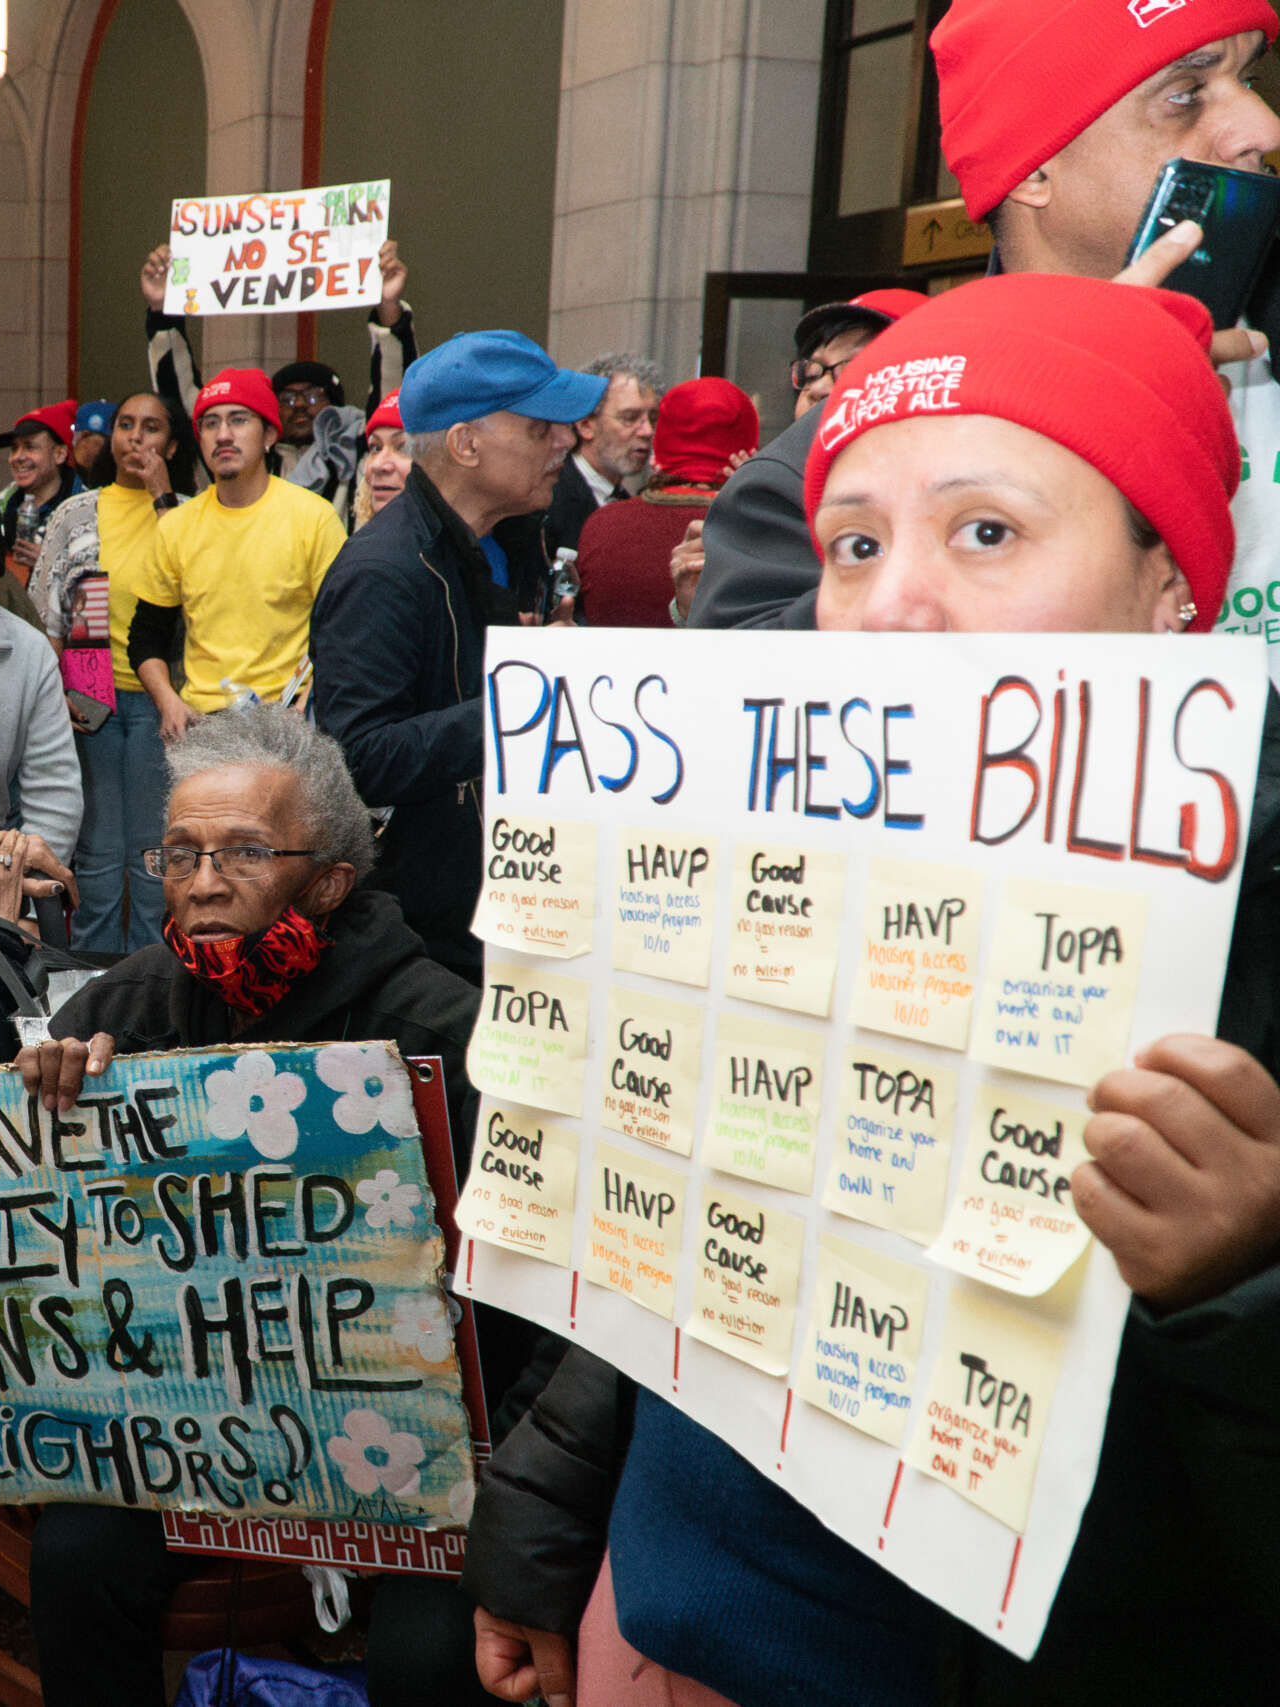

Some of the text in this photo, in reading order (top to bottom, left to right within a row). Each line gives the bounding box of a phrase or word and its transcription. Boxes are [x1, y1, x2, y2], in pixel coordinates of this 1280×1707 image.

[319, 183, 386, 227] PARK
[223, 230, 330, 272] NO SE
[210, 257, 373, 309] VENDE!
[860, 373, 963, 407] JUSTICE
[865, 355, 967, 389] HOUSING
[857, 390, 961, 427] FOR ALL
[487, 660, 684, 804] PASS
[743, 697, 924, 830] THESE
[492, 819, 555, 857] Good
[488, 855, 562, 884] Cause
[627, 844, 710, 888] HAVP
[751, 852, 806, 885] Good
[489, 890, 579, 912] no good reason
[746, 890, 814, 918] Cause
[883, 898, 966, 945] HAVP
[497, 922, 569, 940] no eviction
[1035, 912, 1124, 974] TOPA
[489, 984, 570, 1032] TOPA
[619, 1018, 672, 1061] Good
[611, 1058, 672, 1108] Cause
[730, 1056, 813, 1107] HAVP
[852, 1062, 934, 1118] TOPA
[76, 1082, 188, 1164] THE
[488, 1111, 543, 1161] Good
[990, 1107, 1063, 1159] Good
[480, 1150, 544, 1191] Cause
[981, 1150, 1071, 1205] Cause
[86, 1182, 144, 1246] TO
[155, 1167, 355, 1273] SHED
[472, 1187, 559, 1218] no good reason
[603, 1167, 675, 1229] HAVP
[476, 1217, 547, 1244] no eviction
[707, 1201, 765, 1245] Good
[704, 1238, 768, 1285] Cause
[103, 1278, 163, 1377] &
[181, 1273, 423, 1405] HELP
[830, 1281, 909, 1352] HAVP
[960, 1352, 1032, 1438] TOPA
